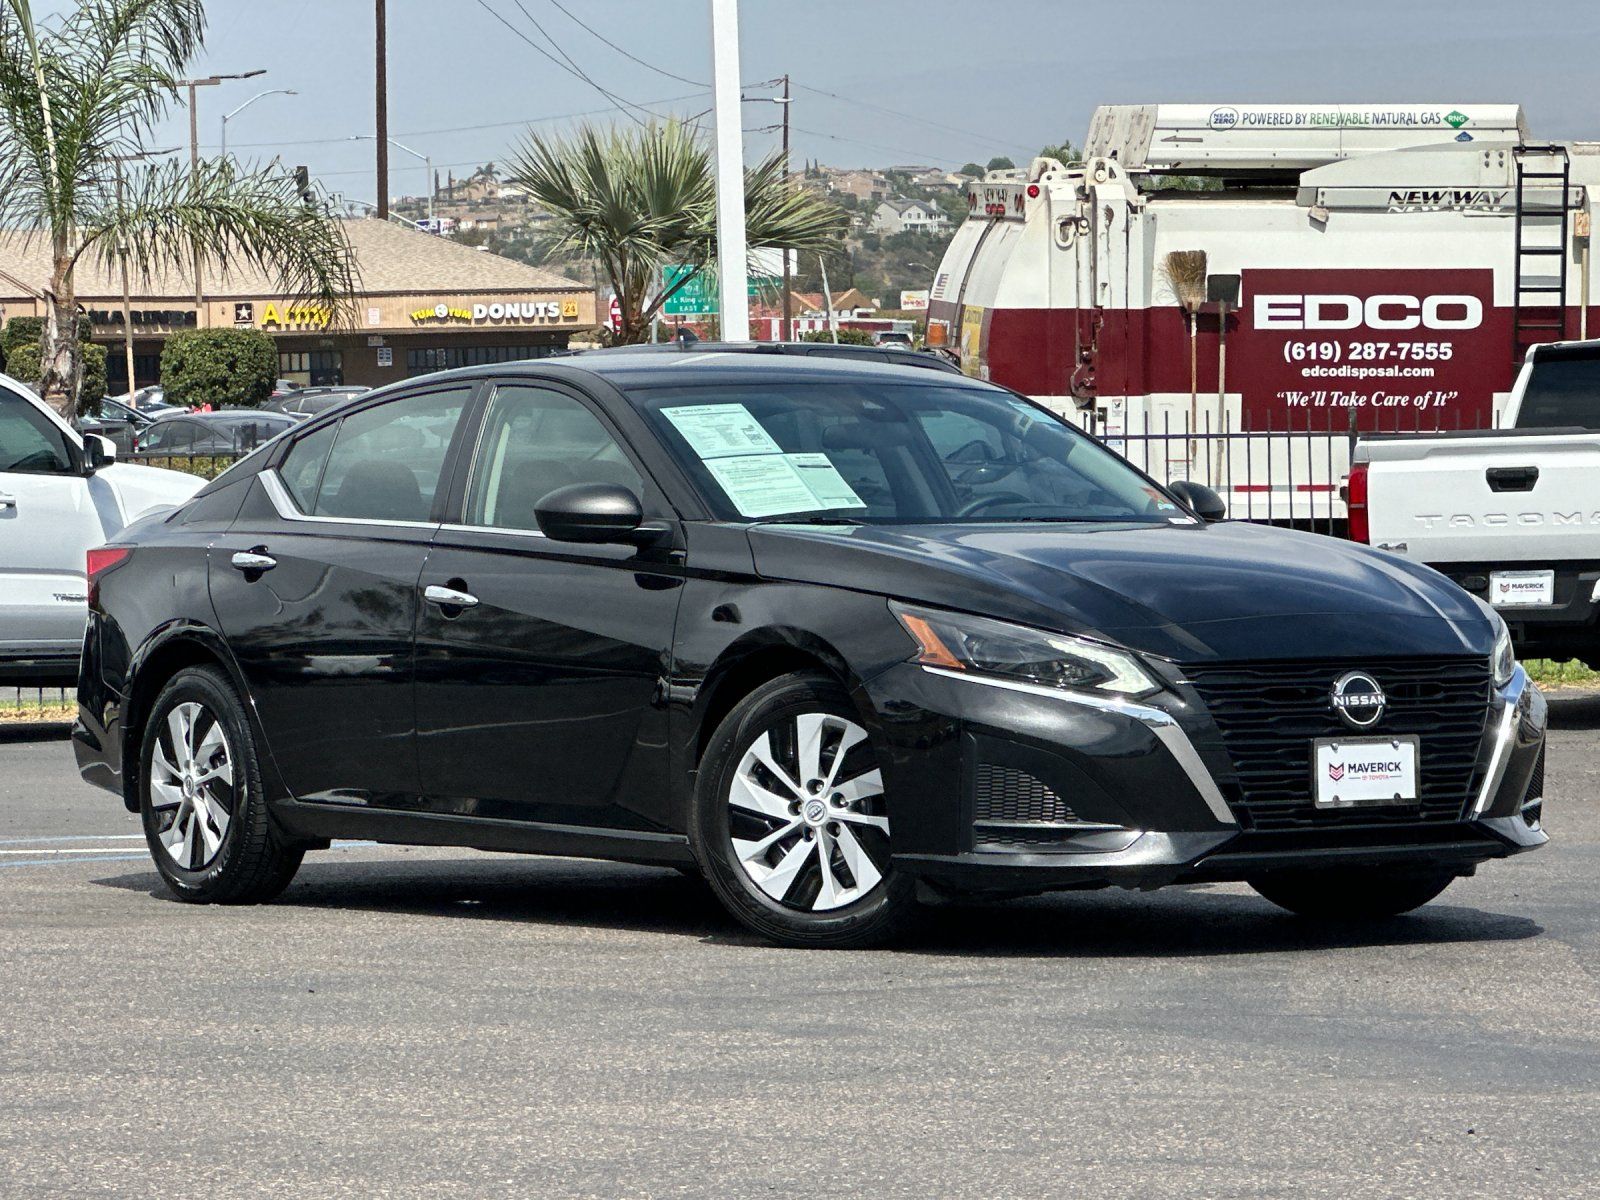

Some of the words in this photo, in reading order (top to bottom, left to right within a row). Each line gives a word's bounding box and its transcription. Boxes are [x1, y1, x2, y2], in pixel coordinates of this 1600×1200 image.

[1242, 112, 1293, 126] POWERED
[1295, 113, 1308, 125] BY
[1309, 112, 1370, 126] RENEWABLE
[1371, 112, 1418, 126] NATURAL
[1420, 112, 1441, 125] GAS
[1447, 114, 1465, 123] RNG
[1388, 191, 1447, 205] NEW
[1453, 191, 1509, 205] WAY
[411, 308, 435, 320] YUM
[449, 308, 472, 319] YUM
[473, 302, 560, 319] DONUTS
[1253, 294, 1483, 330] EDCO
[1283, 340, 1342, 363] (619)
[1348, 342, 1453, 360] 287-7555
[1301, 365, 1435, 379] edcodisposal.com
[1330, 391, 1367, 407] Take
[1371, 391, 1409, 407] Care
[1413, 391, 1431, 410] of
[1333, 694, 1387, 706] NISSAN
[1347, 761, 1402, 773] MAVERICK
